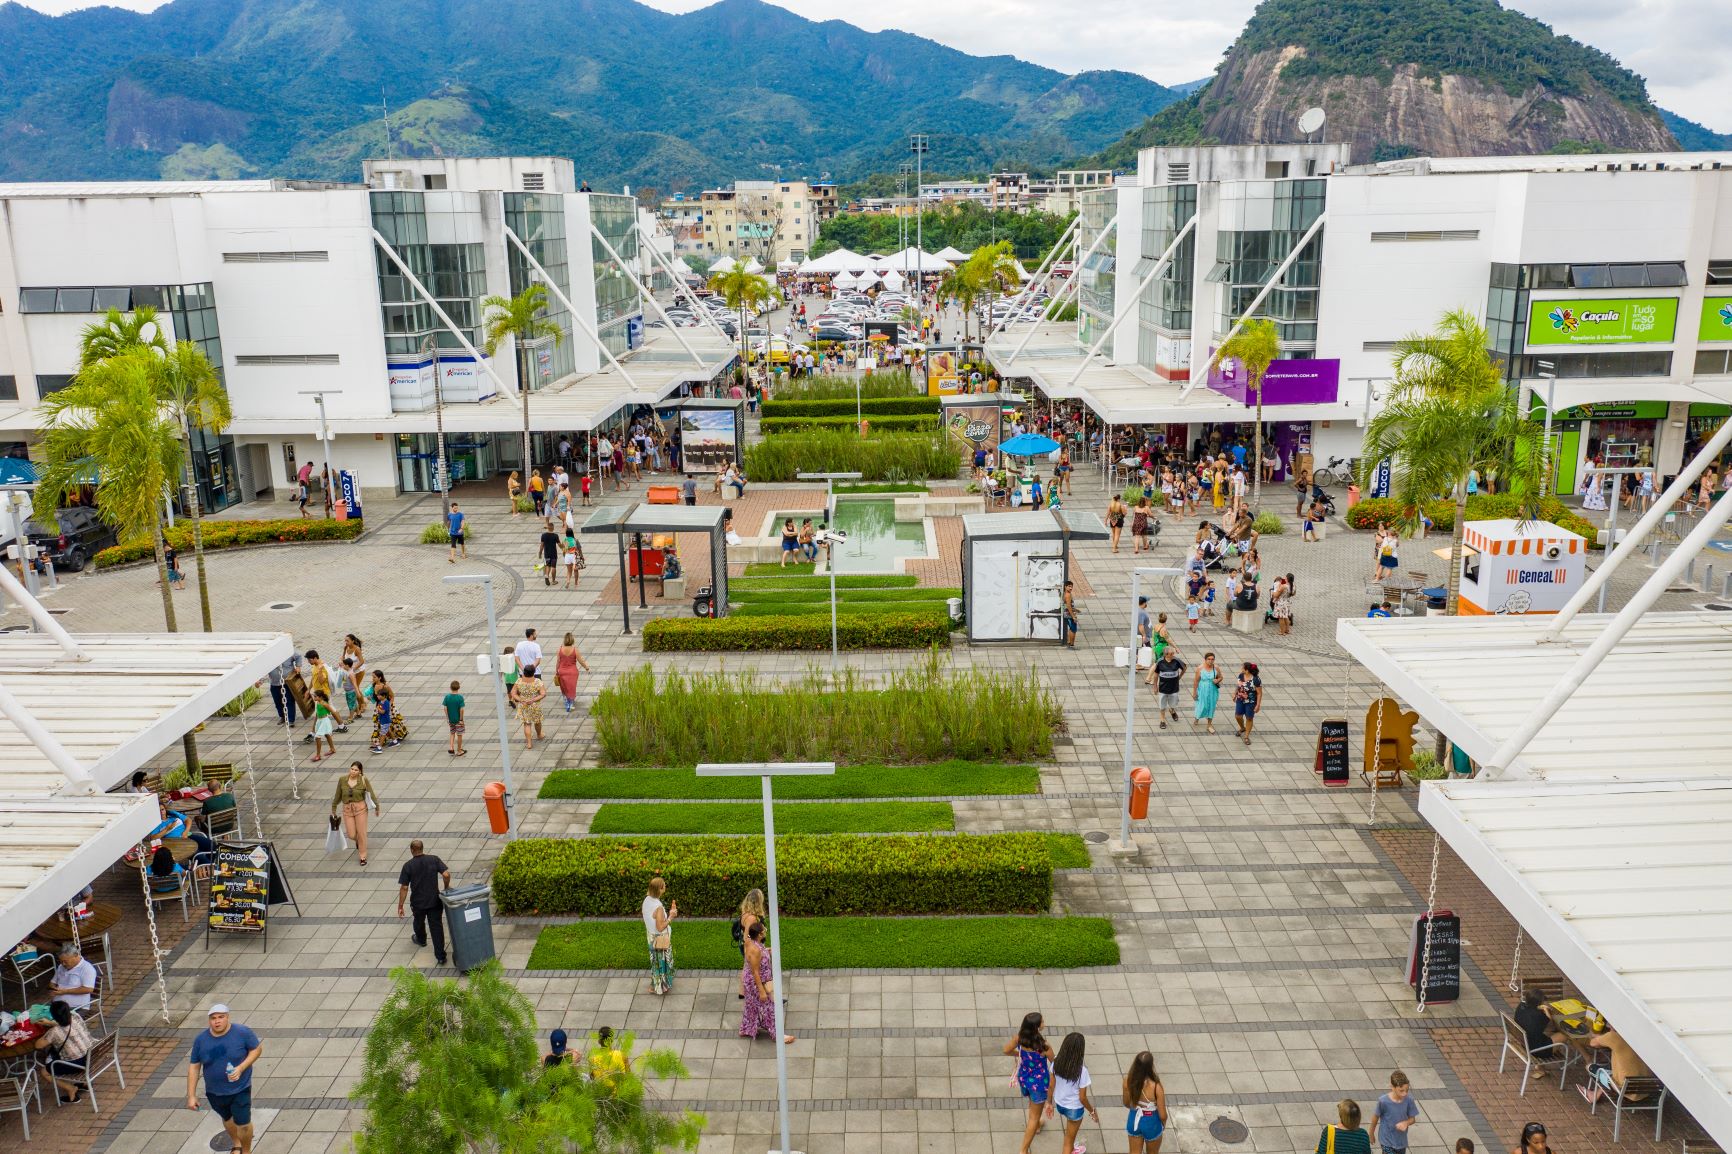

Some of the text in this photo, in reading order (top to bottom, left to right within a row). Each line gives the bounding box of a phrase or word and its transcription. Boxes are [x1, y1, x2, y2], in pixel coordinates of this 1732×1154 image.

[1632, 305, 1656, 315] Tudo
[1580, 310, 1620, 324] Caçula
[1632, 322, 1655, 332] lugar
[1379, 469, 1389, 498] BLOCO
[343, 483, 353, 513] BLOCO
[219, 852, 249, 862] COMBOS
